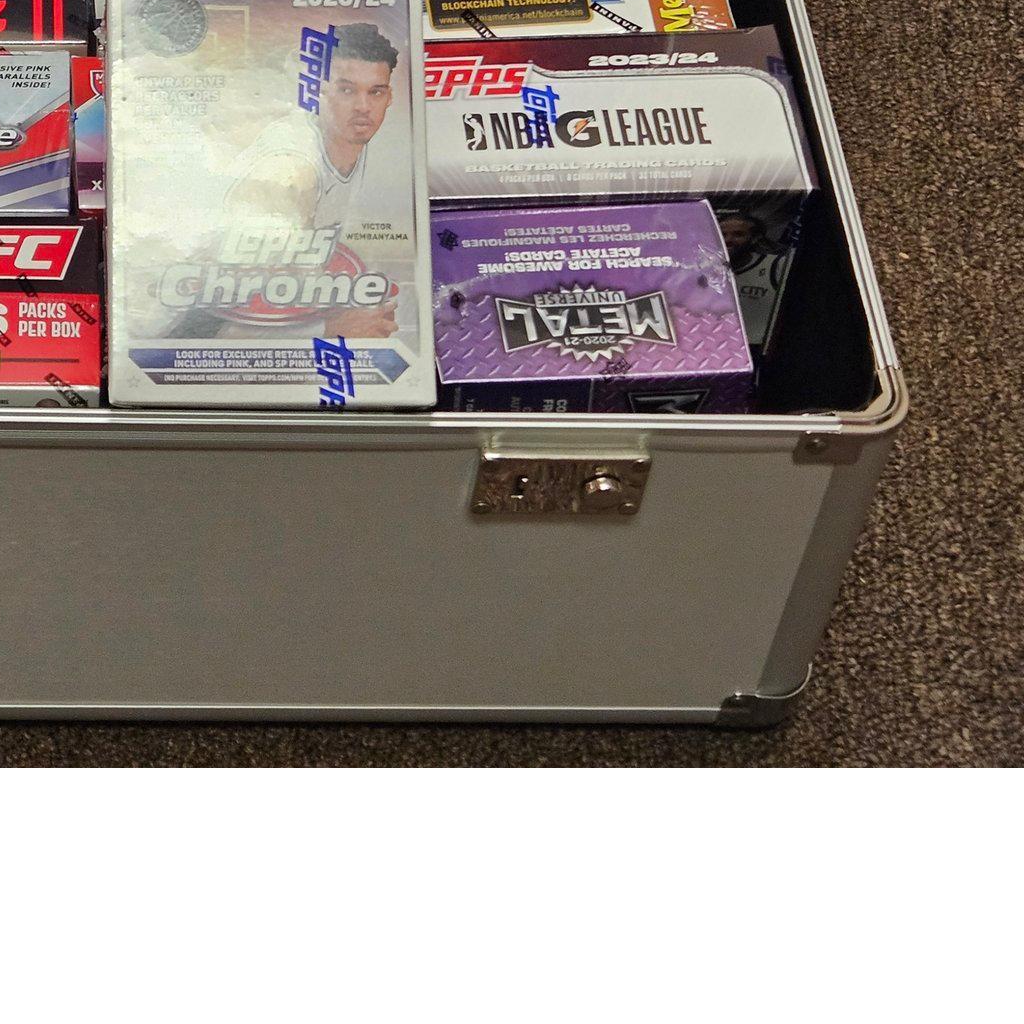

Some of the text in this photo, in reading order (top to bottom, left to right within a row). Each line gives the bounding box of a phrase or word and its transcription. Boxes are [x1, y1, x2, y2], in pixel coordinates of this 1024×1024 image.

[442, 0, 504, 10] BLOCKCHAIN
[587, 52, 718, 67] 2023/24
[604, 107, 712, 147] LEAGUE
[465, 160, 656, 173] BASKETBALL TRADING
[579, 224, 631, 233] CARTES
[461, 232, 678, 248] RECHERCHEZ LES MAGNIFIQUES
[504, 247, 641, 262] ACETATE CARDS!
[478, 261, 602, 274] FOR AWESOME
[157, 262, 391, 307] Chrome
[536, 292, 623, 306] UNIVERSE
[18, 302, 67, 319] PACKS
[503, 295, 670, 342] METAL
[18, 320, 81, 338] PER BOX
[564, 336, 617, 346] 2020-21
[176, 351, 201, 359] LOOK
[203, 351, 221, 359] FOR
[223, 351, 273, 359] EXCLUSIVE
[174, 359, 311, 368] INCLUDING AND SP PINK
